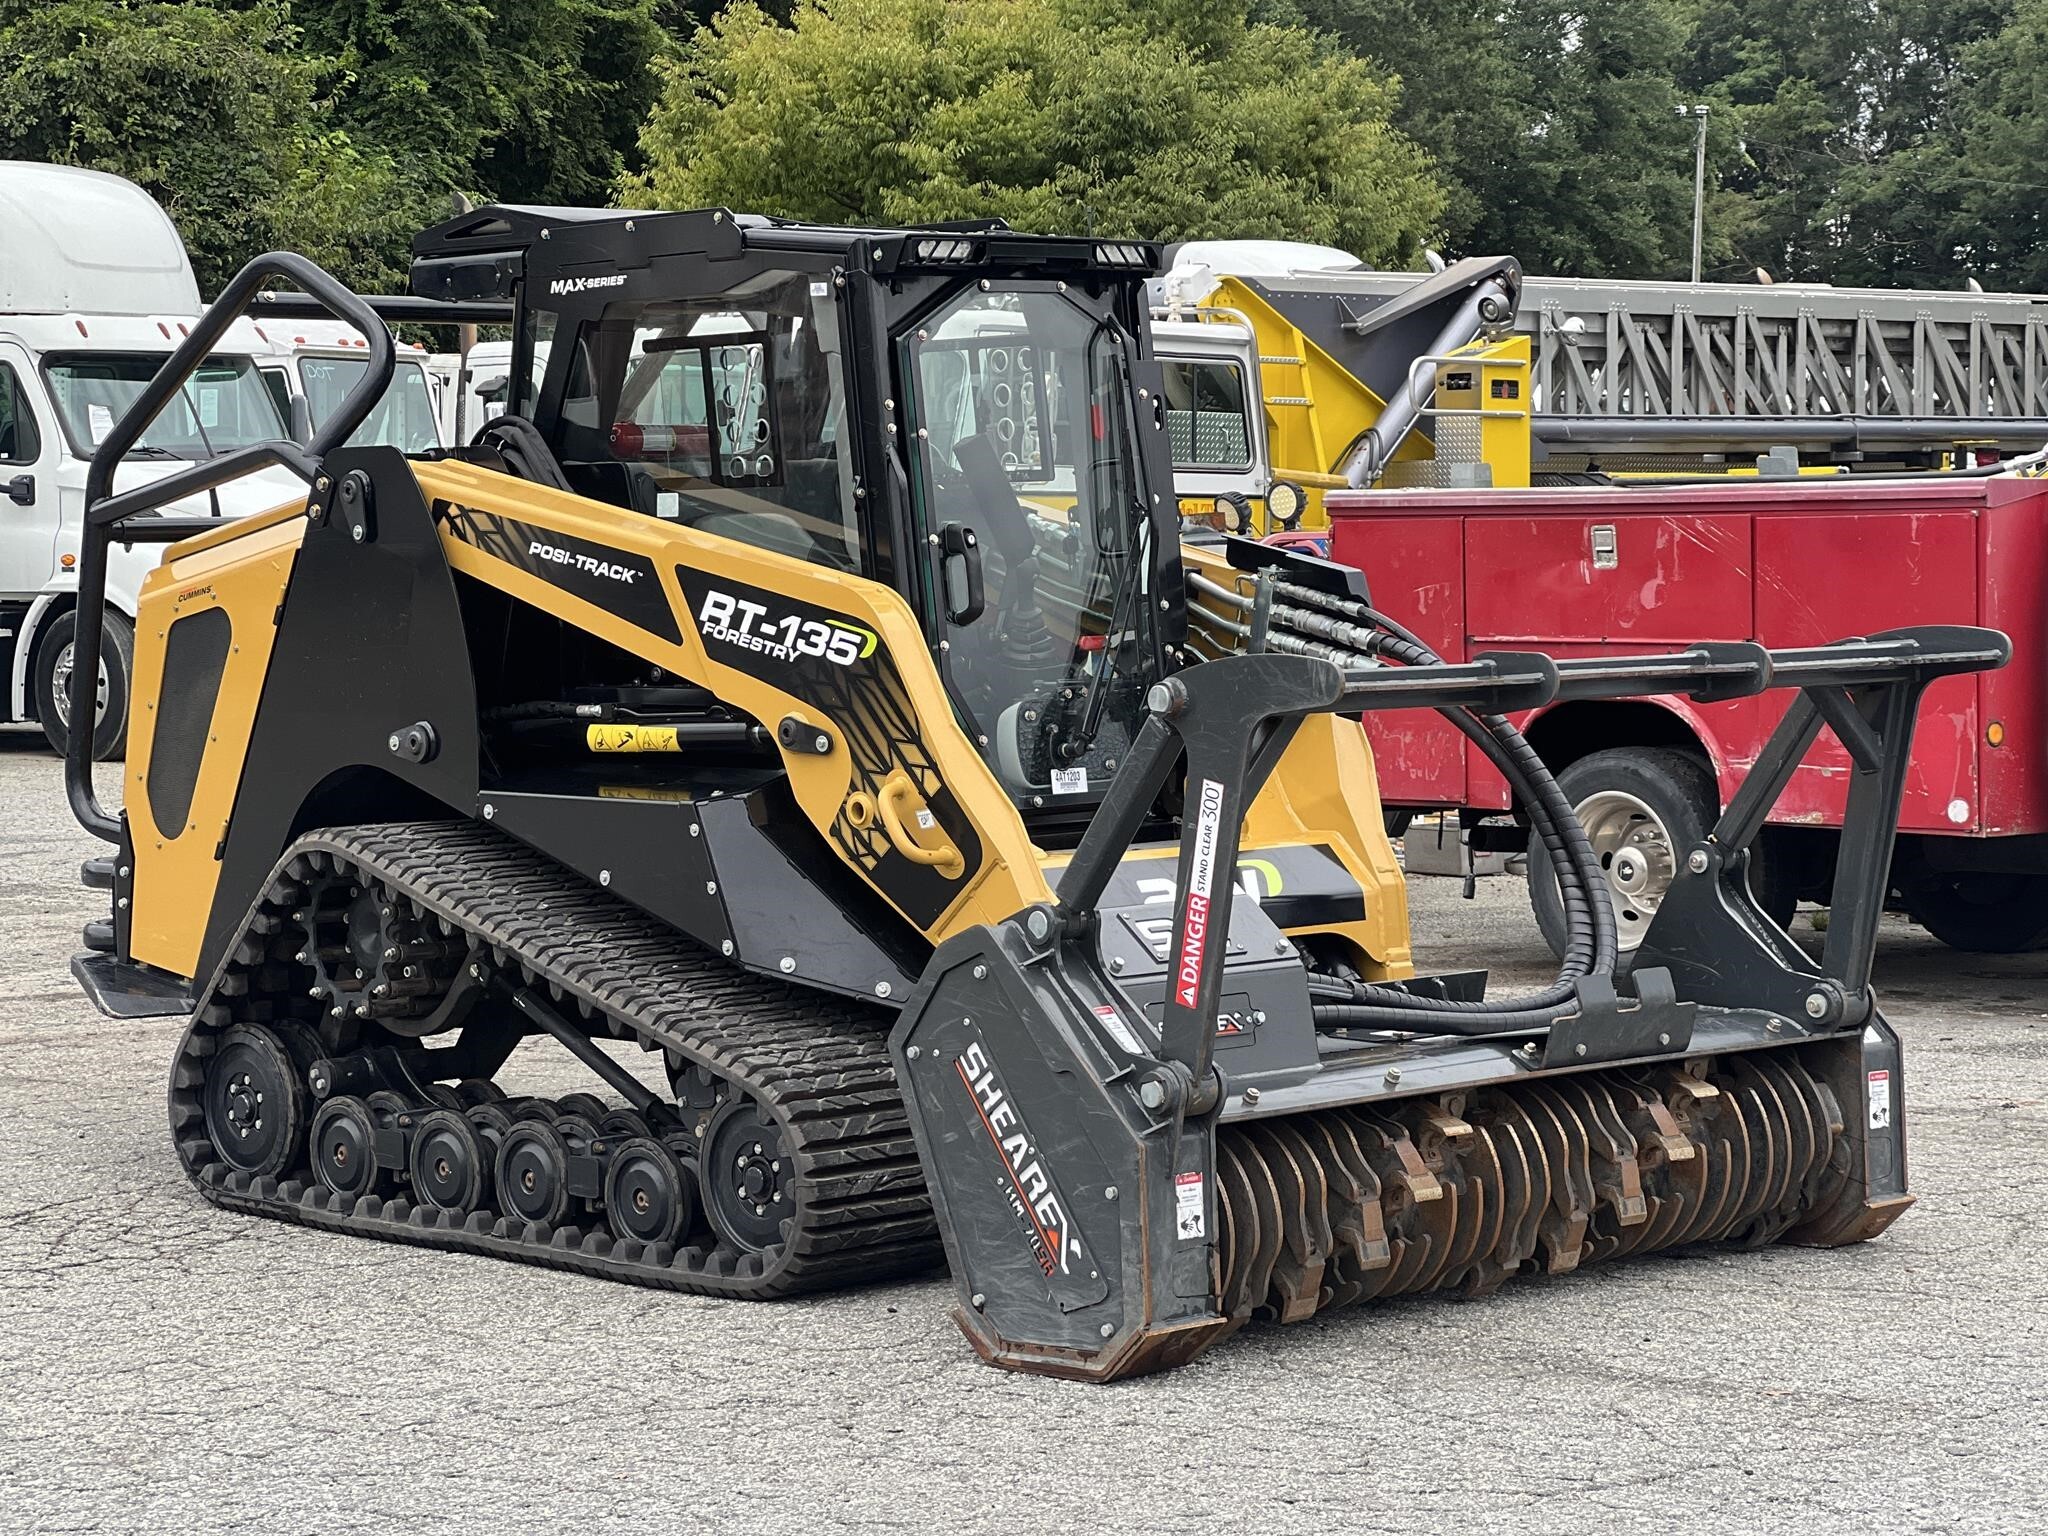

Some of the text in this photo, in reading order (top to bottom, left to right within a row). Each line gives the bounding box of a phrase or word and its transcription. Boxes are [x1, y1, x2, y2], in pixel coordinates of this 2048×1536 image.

[550, 275, 627, 295] MAX-SERIES
[305, 364, 335, 382] DOT
[528, 541, 636, 584] POSI-TRACK
[178, 585, 213, 603] CUMMINS
[699, 590, 862, 666] RT-135
[702, 622, 801, 663] FORESTRY
[1181, 783, 1220, 985] DANGER STAND CLEAR 300'
[960, 1042, 1082, 1275] SHEAREX
